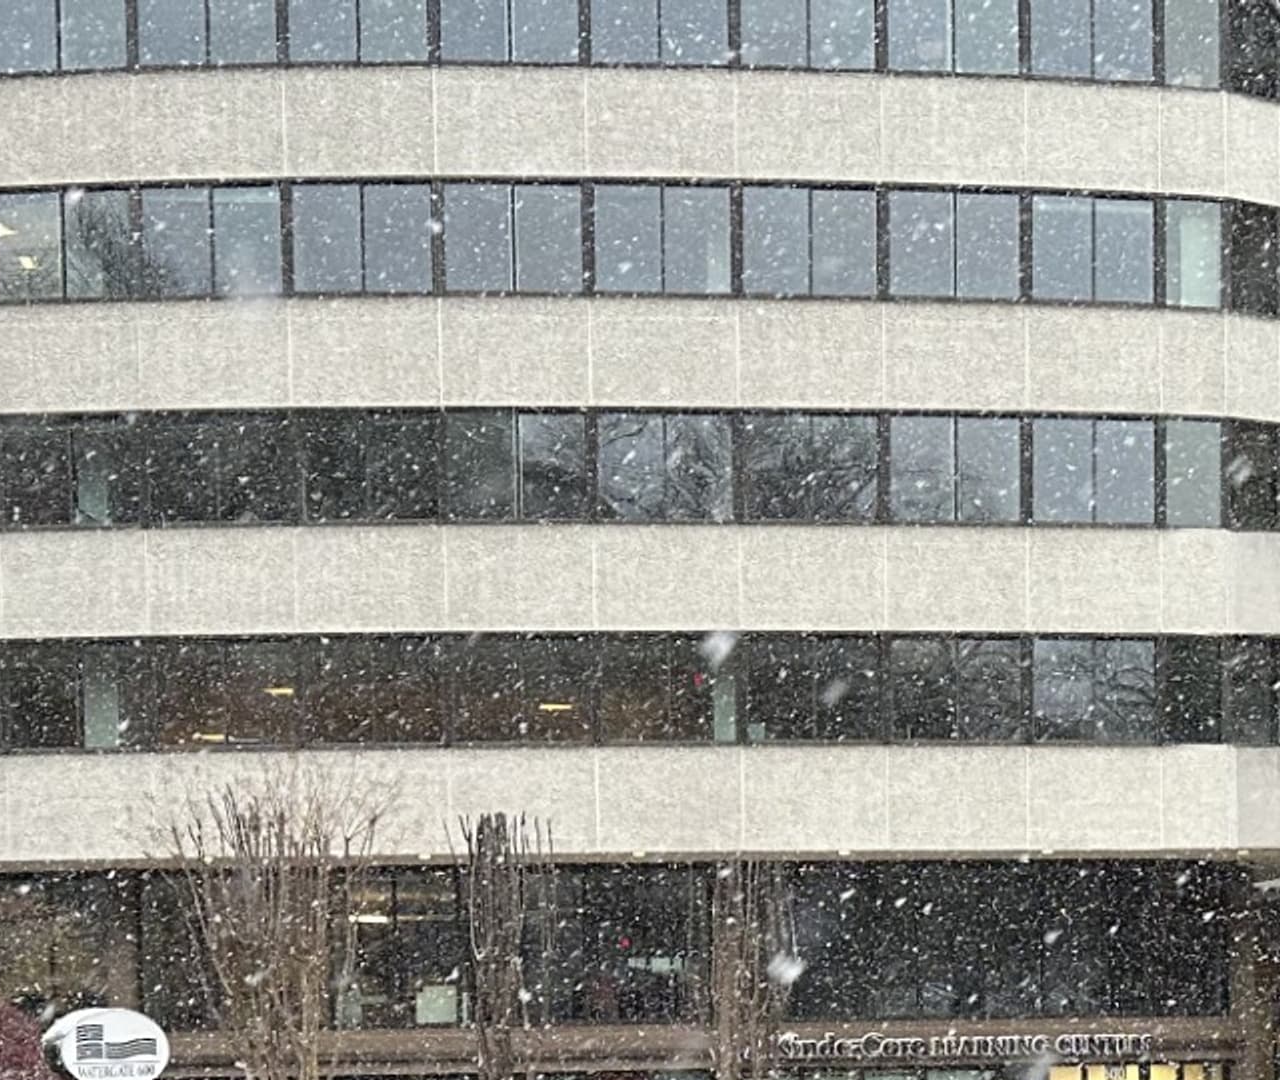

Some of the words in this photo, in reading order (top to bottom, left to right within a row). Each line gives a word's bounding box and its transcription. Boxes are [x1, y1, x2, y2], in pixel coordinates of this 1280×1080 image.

[777, 1032, 925, 1057] KinderCare
[929, 1034, 1049, 1056] LEARNING
[78, 1063, 134, 1079] WATERGATE
